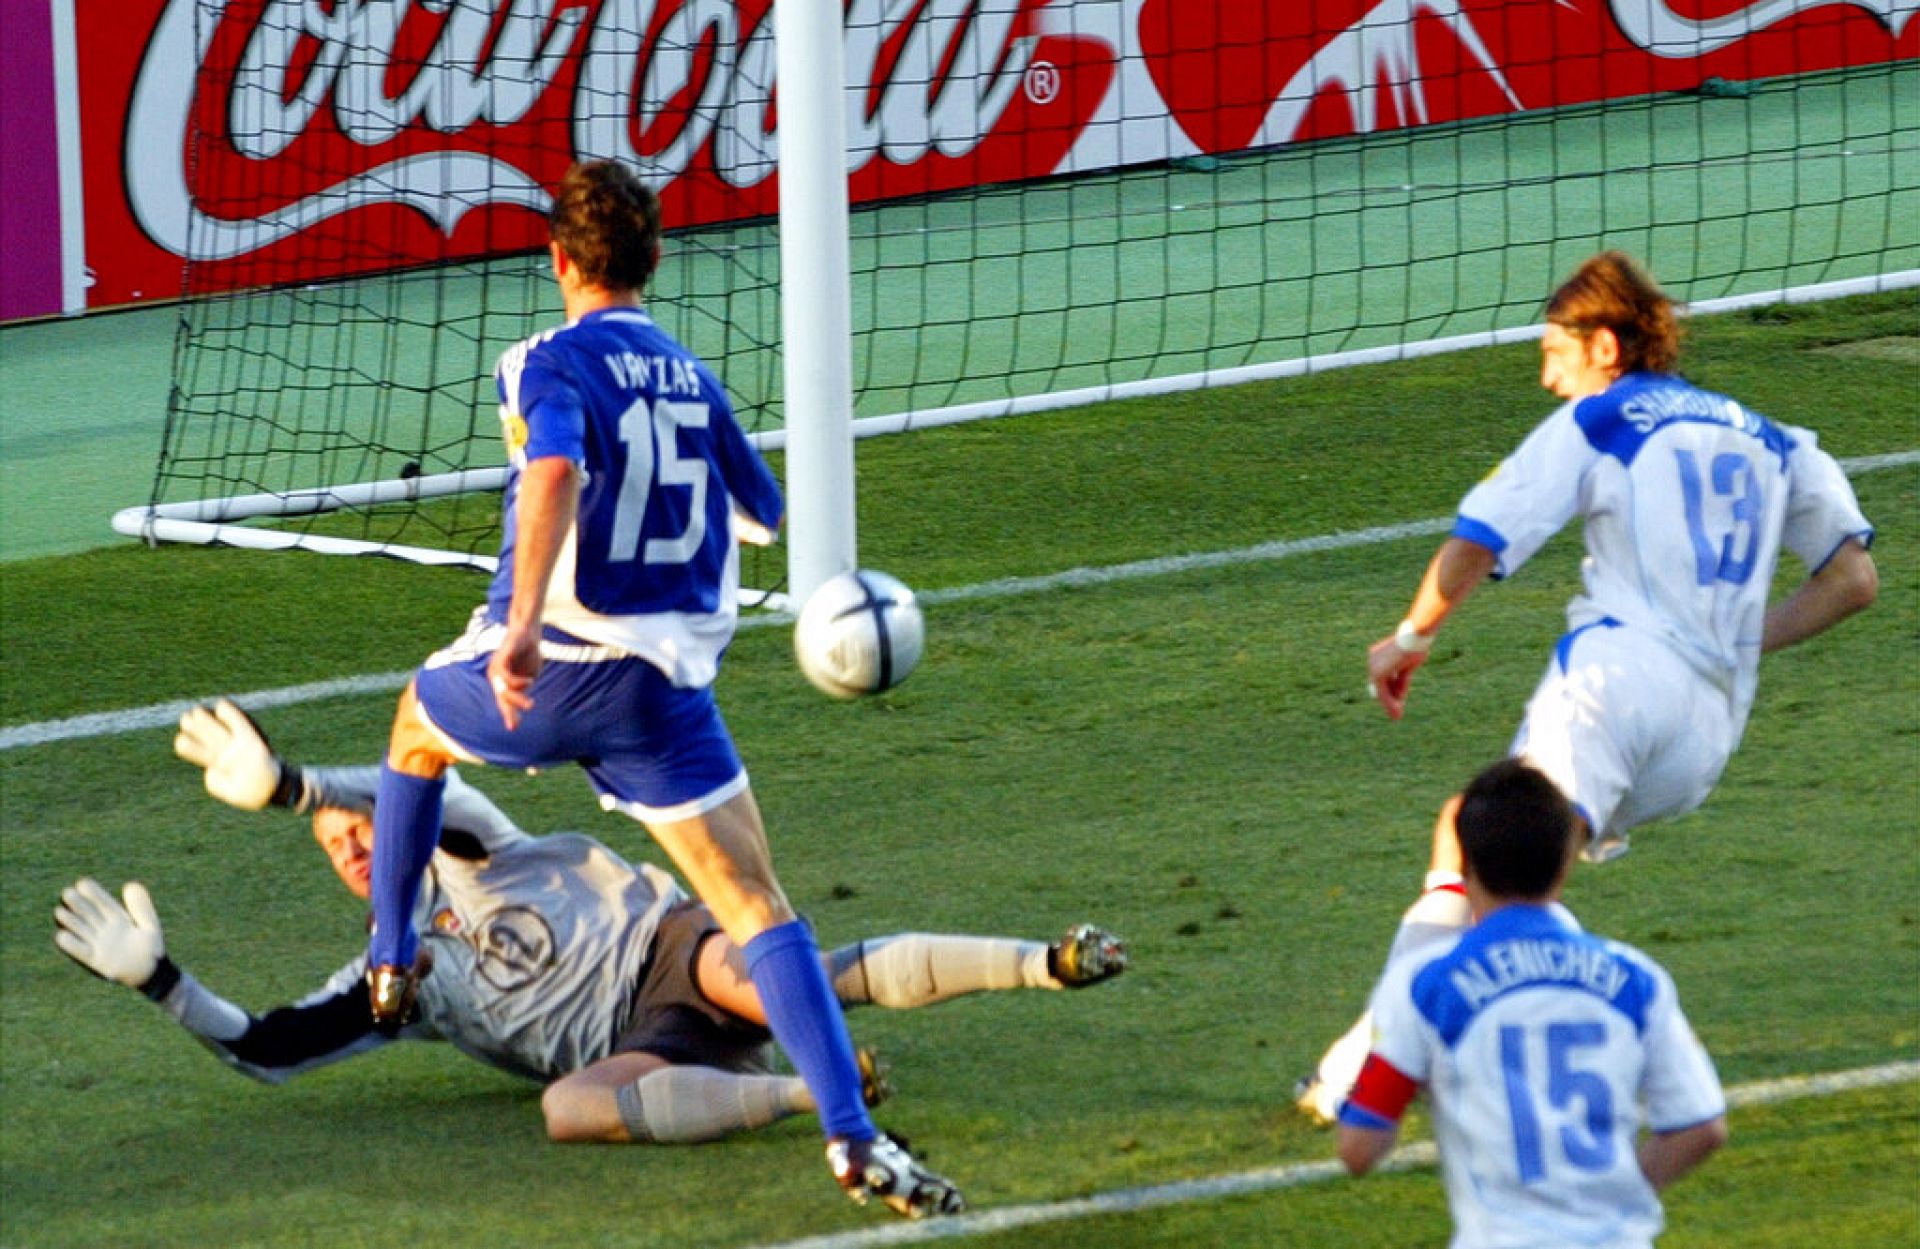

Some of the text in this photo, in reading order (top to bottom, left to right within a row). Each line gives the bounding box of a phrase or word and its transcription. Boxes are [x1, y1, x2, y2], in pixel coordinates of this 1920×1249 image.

[122, 0, 1040, 261] CocaCoa
[608, 397, 709, 564] 15
[1674, 449, 1763, 586] 13
[1450, 938, 1631, 1012] ALENICHEV
[1500, 1022, 1616, 1185] 15
